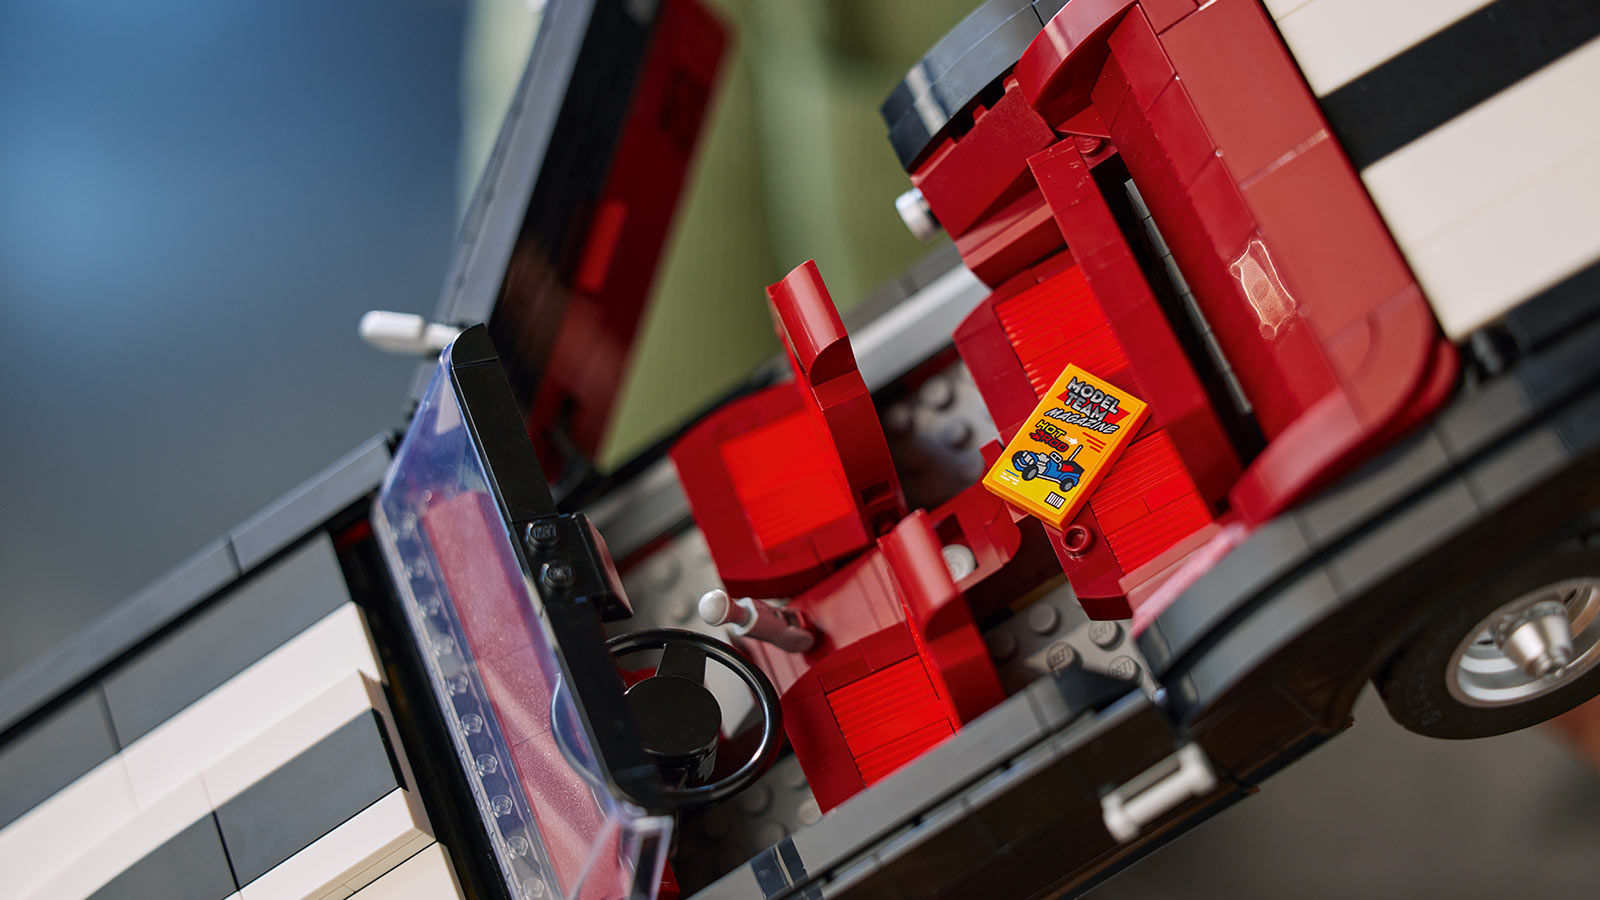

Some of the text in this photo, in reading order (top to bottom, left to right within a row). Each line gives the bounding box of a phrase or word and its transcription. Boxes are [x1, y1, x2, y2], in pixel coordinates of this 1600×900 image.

[1064, 391, 1109, 421] TEAM
[1066, 376, 1120, 414] MODEL
[1035, 419, 1067, 437] HOT
[1044, 407, 1120, 434] MAGAZINE
